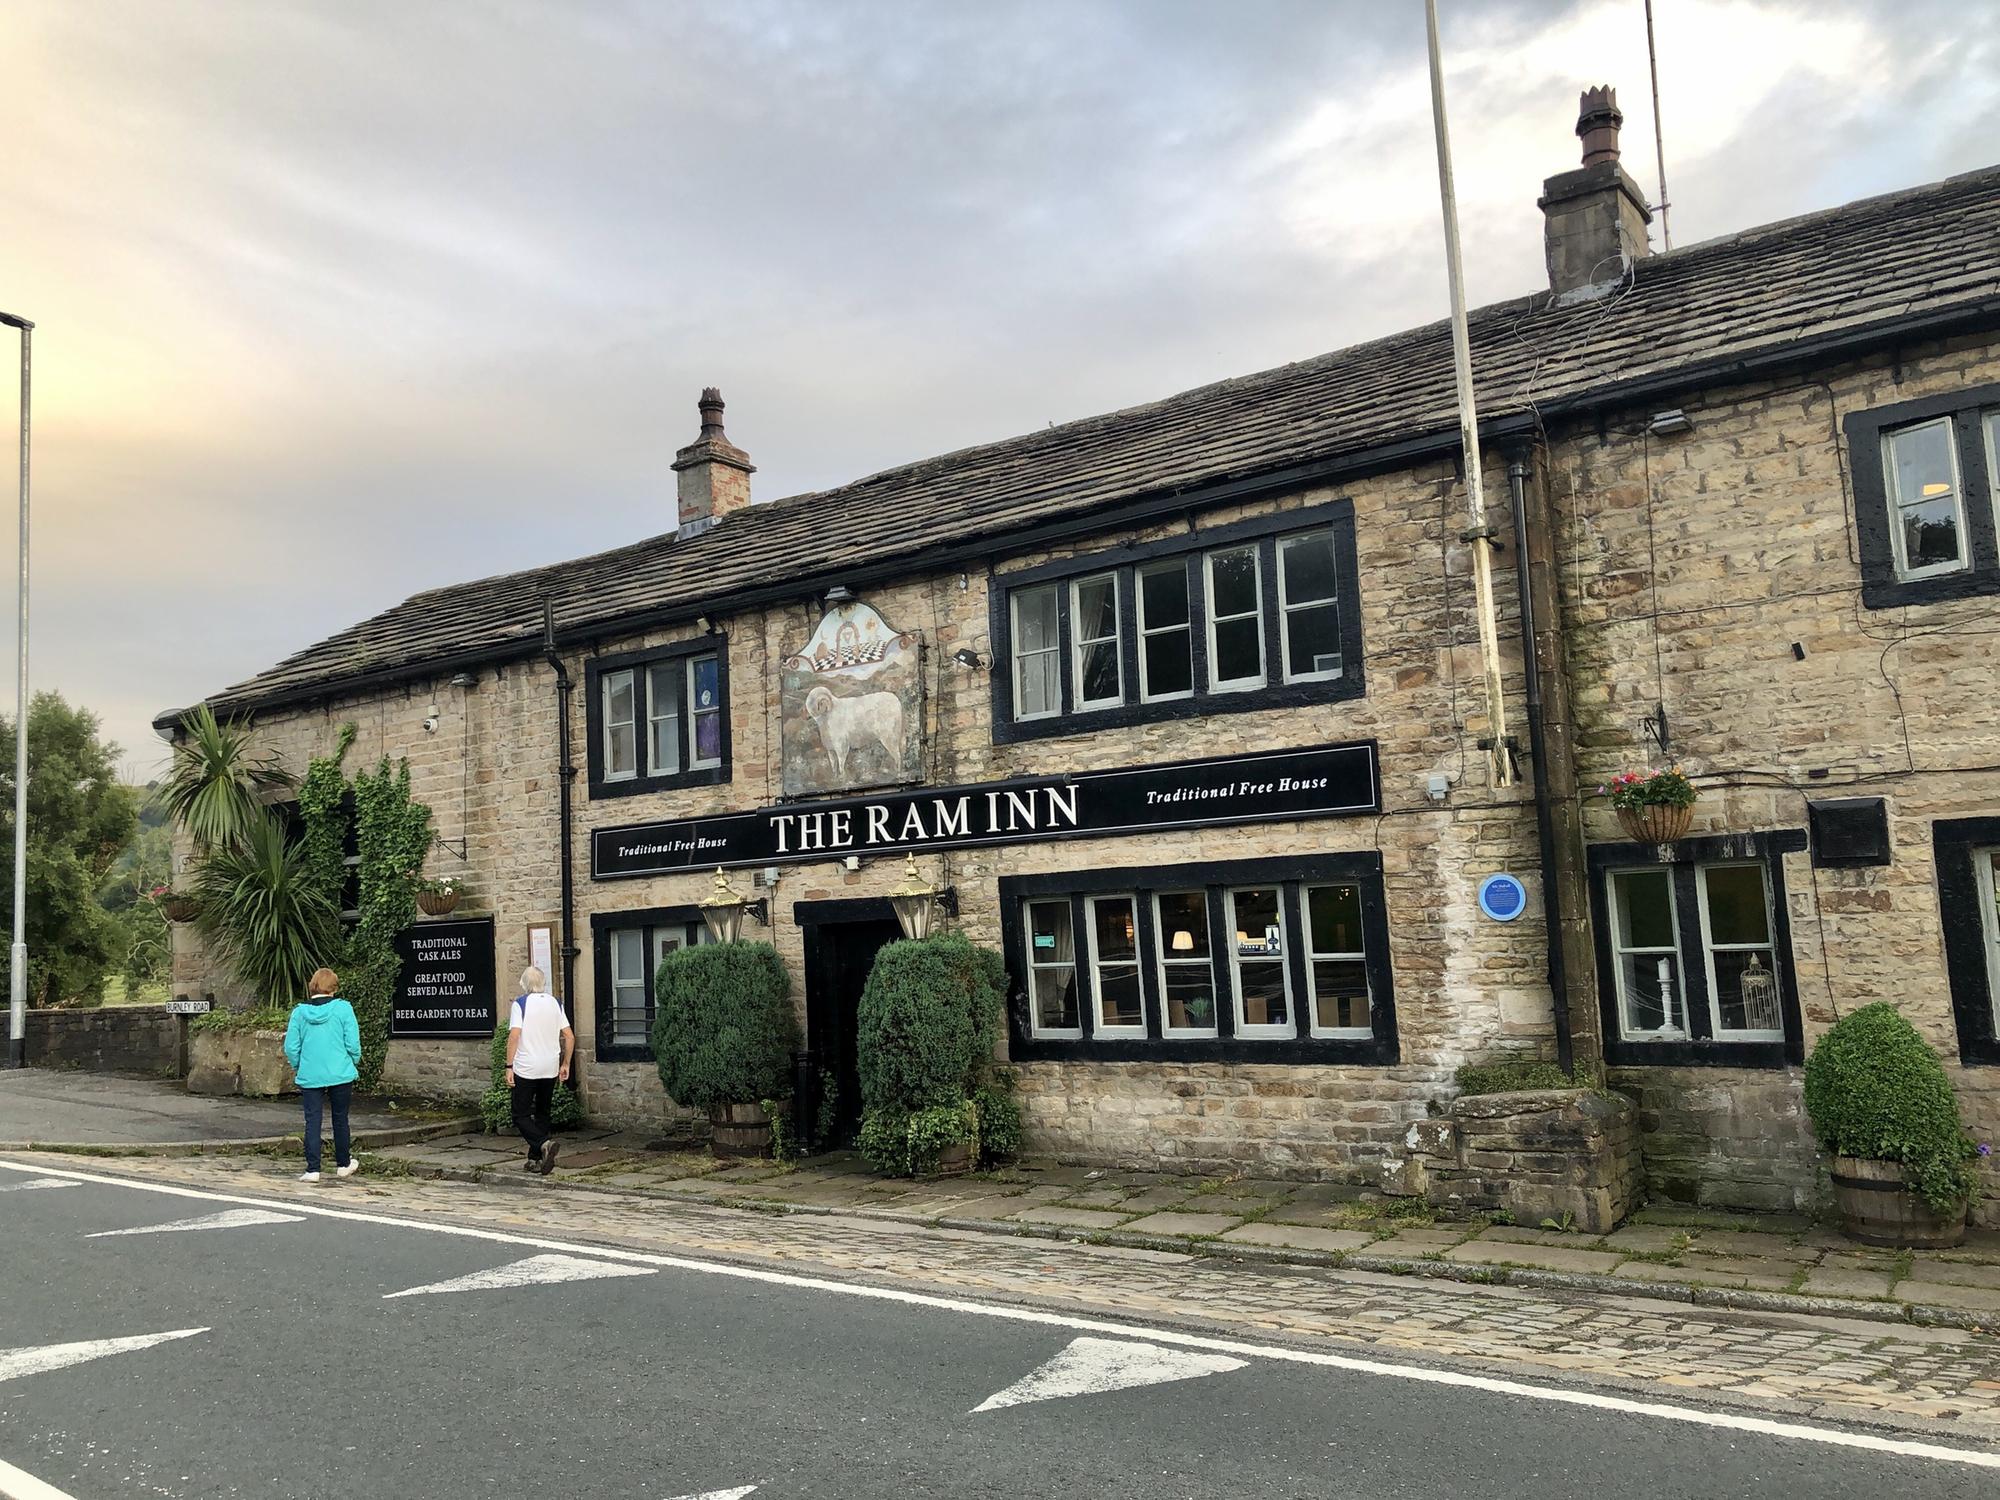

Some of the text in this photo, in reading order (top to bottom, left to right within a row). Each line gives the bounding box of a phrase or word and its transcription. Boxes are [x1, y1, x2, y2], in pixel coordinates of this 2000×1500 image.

[1147, 777, 1328, 805] Traditional Free House
[770, 784, 1080, 853] THE RAM INN
[618, 837, 727, 857] Traditional Free House
[411, 937, 468, 949] TRADITIONAL
[418, 950, 461, 961] CASK ALES
[415, 972, 466, 983] GREAT FOOD
[407, 985, 474, 996] SERVED ALL DAY
[193, 1002, 209, 1012] ROAD
[395, 1008, 488, 1019] BEER GARDEN TO REAR
